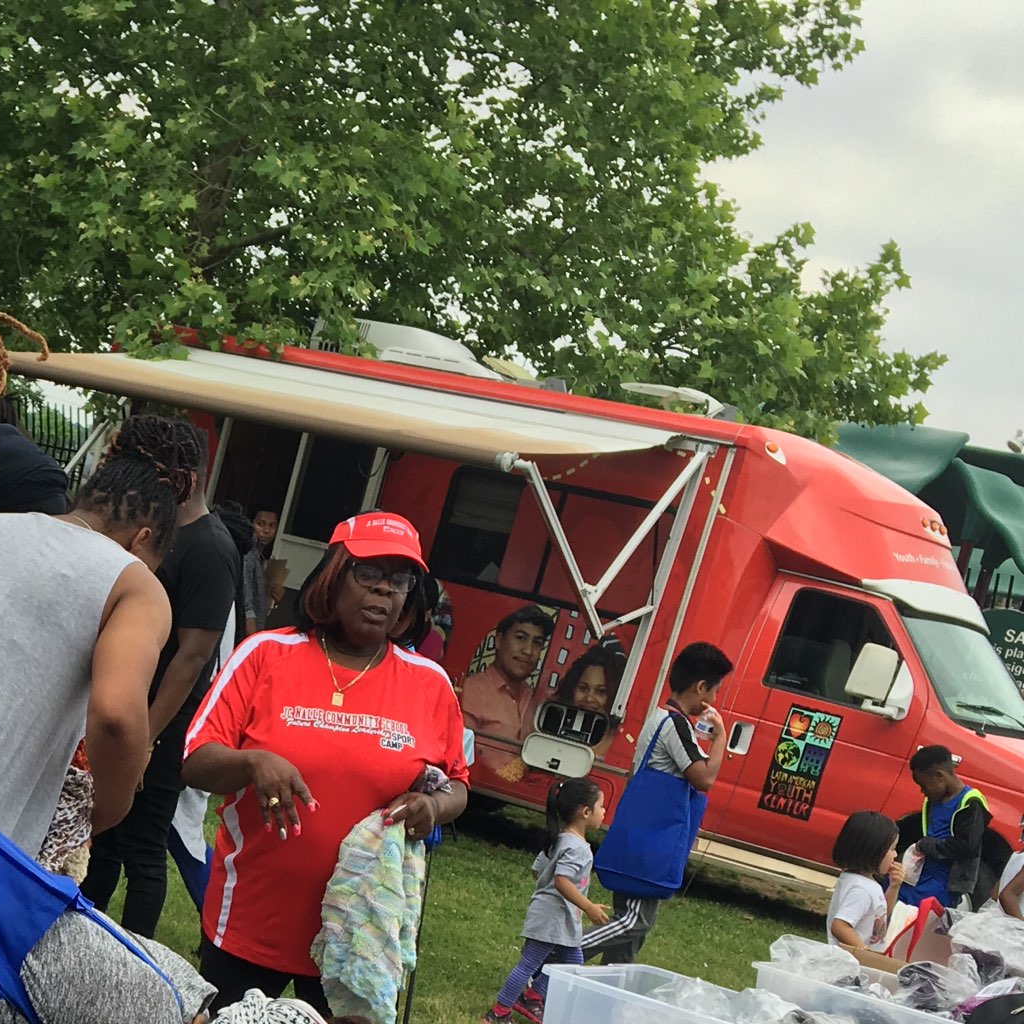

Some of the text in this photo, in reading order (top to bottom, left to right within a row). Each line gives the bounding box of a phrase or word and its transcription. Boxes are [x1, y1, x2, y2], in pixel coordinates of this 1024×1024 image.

[893, 552, 917, 564] Youth
[1004, 647, 1024, 664] pla
[281, 706, 410, 735] JC NALLE COMMUNITY SCHOOL
[380, 739, 402, 752] CAMP
[391, 733, 415, 747] SPORT
[771, 769, 816, 789] LATIN AMERICAN
[770, 780, 813, 803] YOUTH
[764, 793, 810, 816] CENTER
